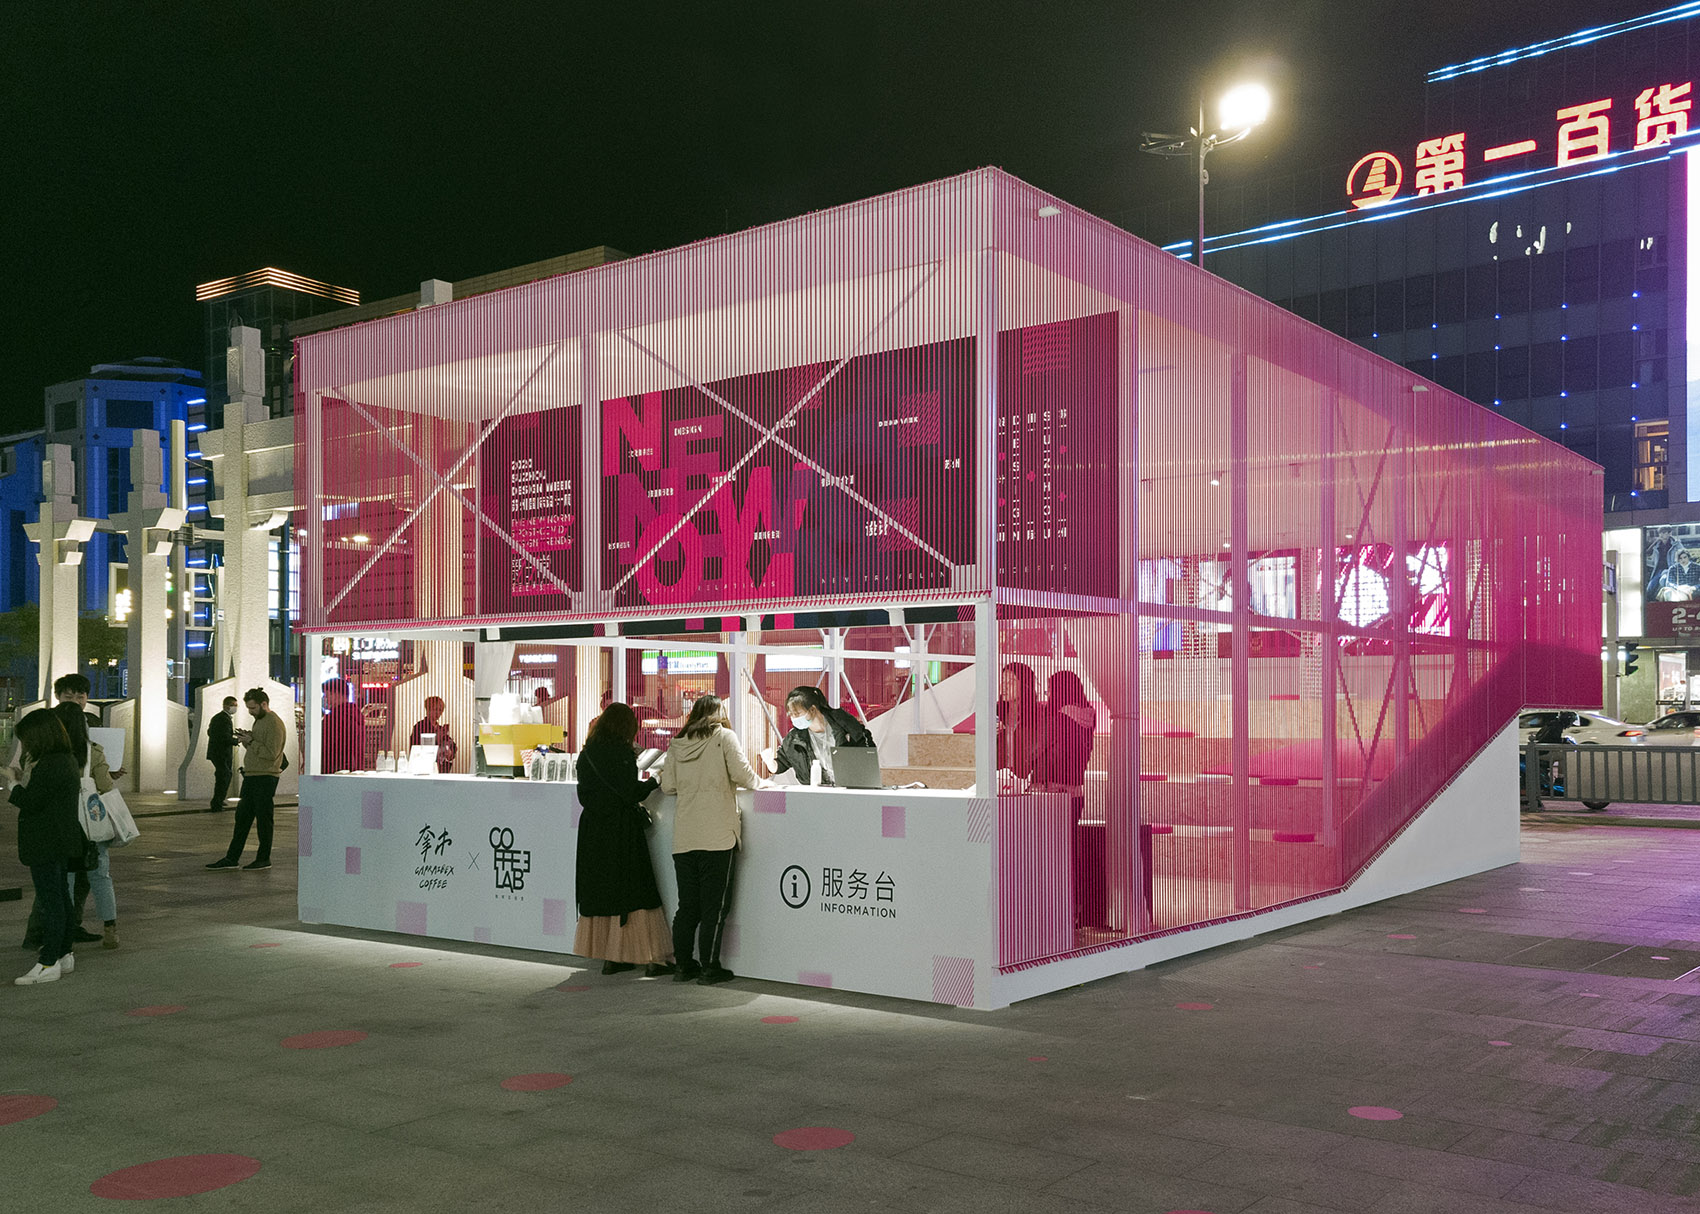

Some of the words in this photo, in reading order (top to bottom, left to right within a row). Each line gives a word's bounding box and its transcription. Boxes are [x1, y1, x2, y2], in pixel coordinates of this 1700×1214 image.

[1415, 80, 1692, 198] 第一百货
[419, 878, 448, 891] COFFEE
[821, 867, 896, 903] 服务台
[820, 902, 897, 919] INFORMATION
